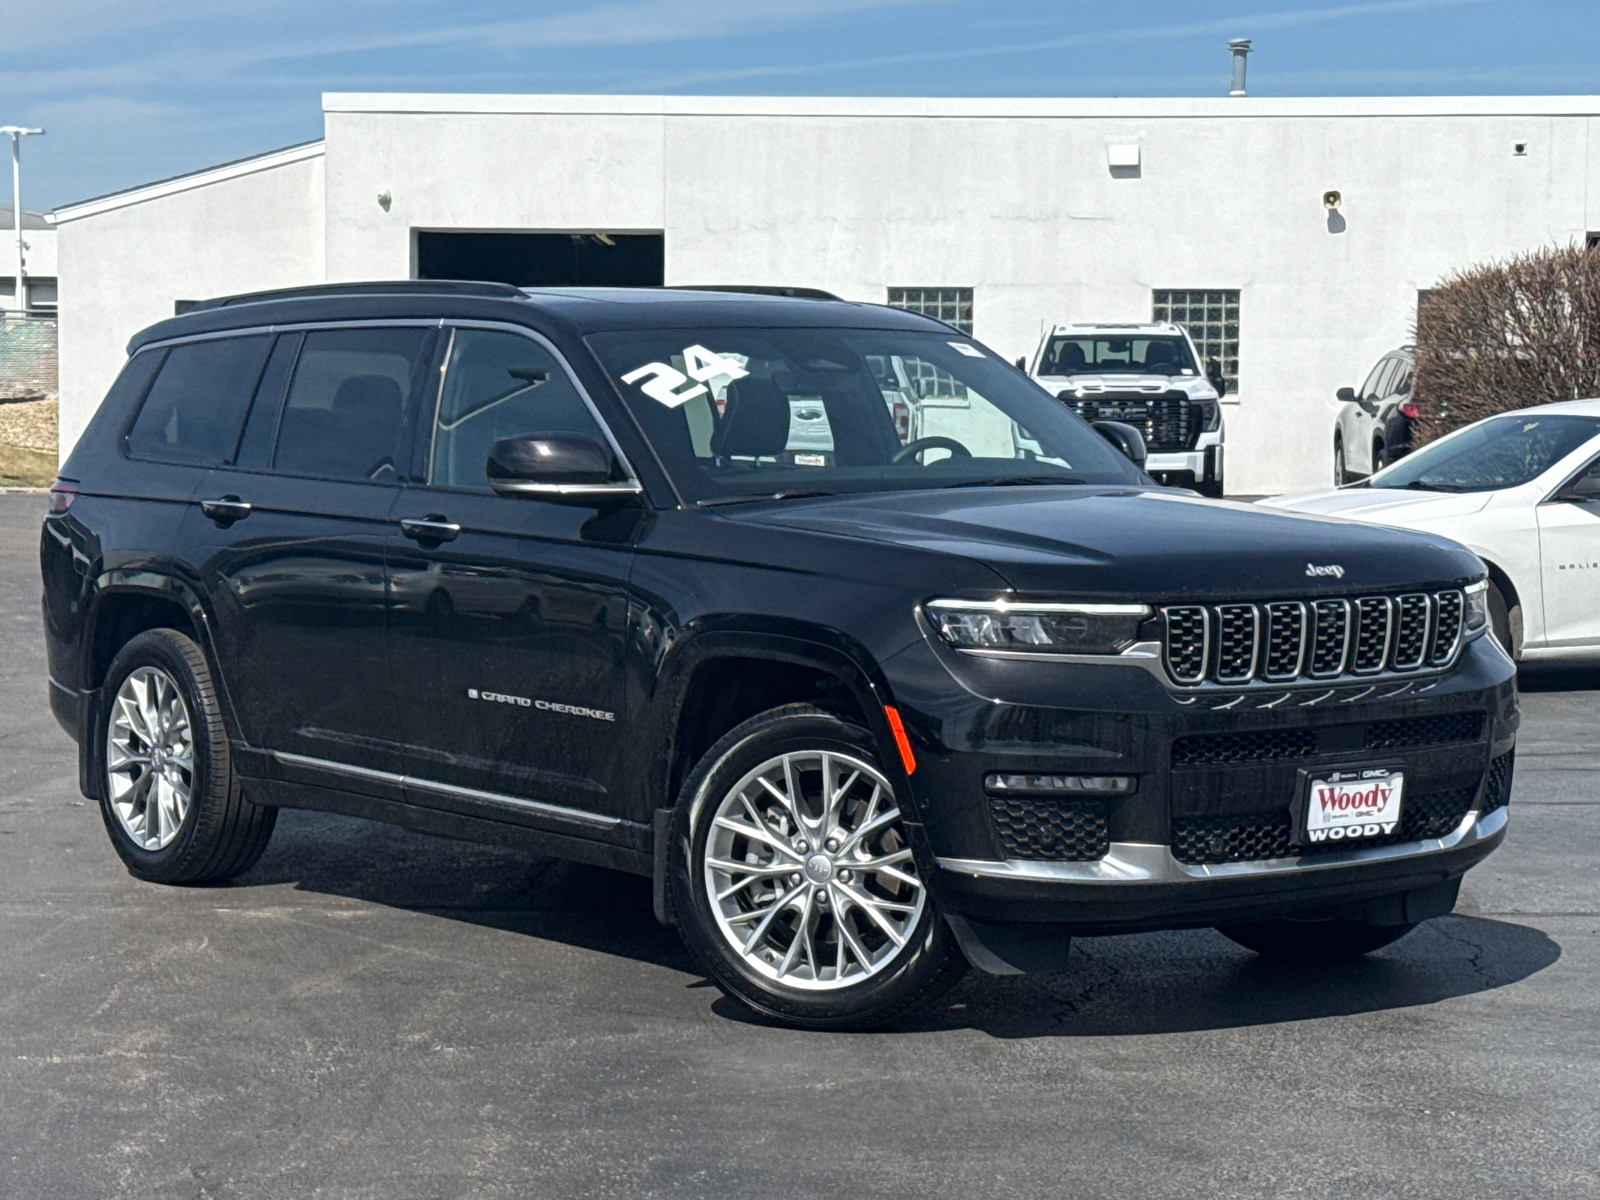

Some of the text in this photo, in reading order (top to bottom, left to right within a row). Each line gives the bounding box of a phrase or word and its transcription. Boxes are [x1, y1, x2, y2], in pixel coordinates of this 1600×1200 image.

[620, 344, 750, 409] 24
[1098, 407, 1148, 418] GMC
[1305, 562, 1345, 579] Jeep
[481, 691, 616, 722] GRAND CHEROKEE
[1362, 769, 1387, 779] GMC
[1317, 783, 1393, 813] Woody
[1355, 810, 1375, 818] GMC
[1309, 822, 1397, 842] WOODY
